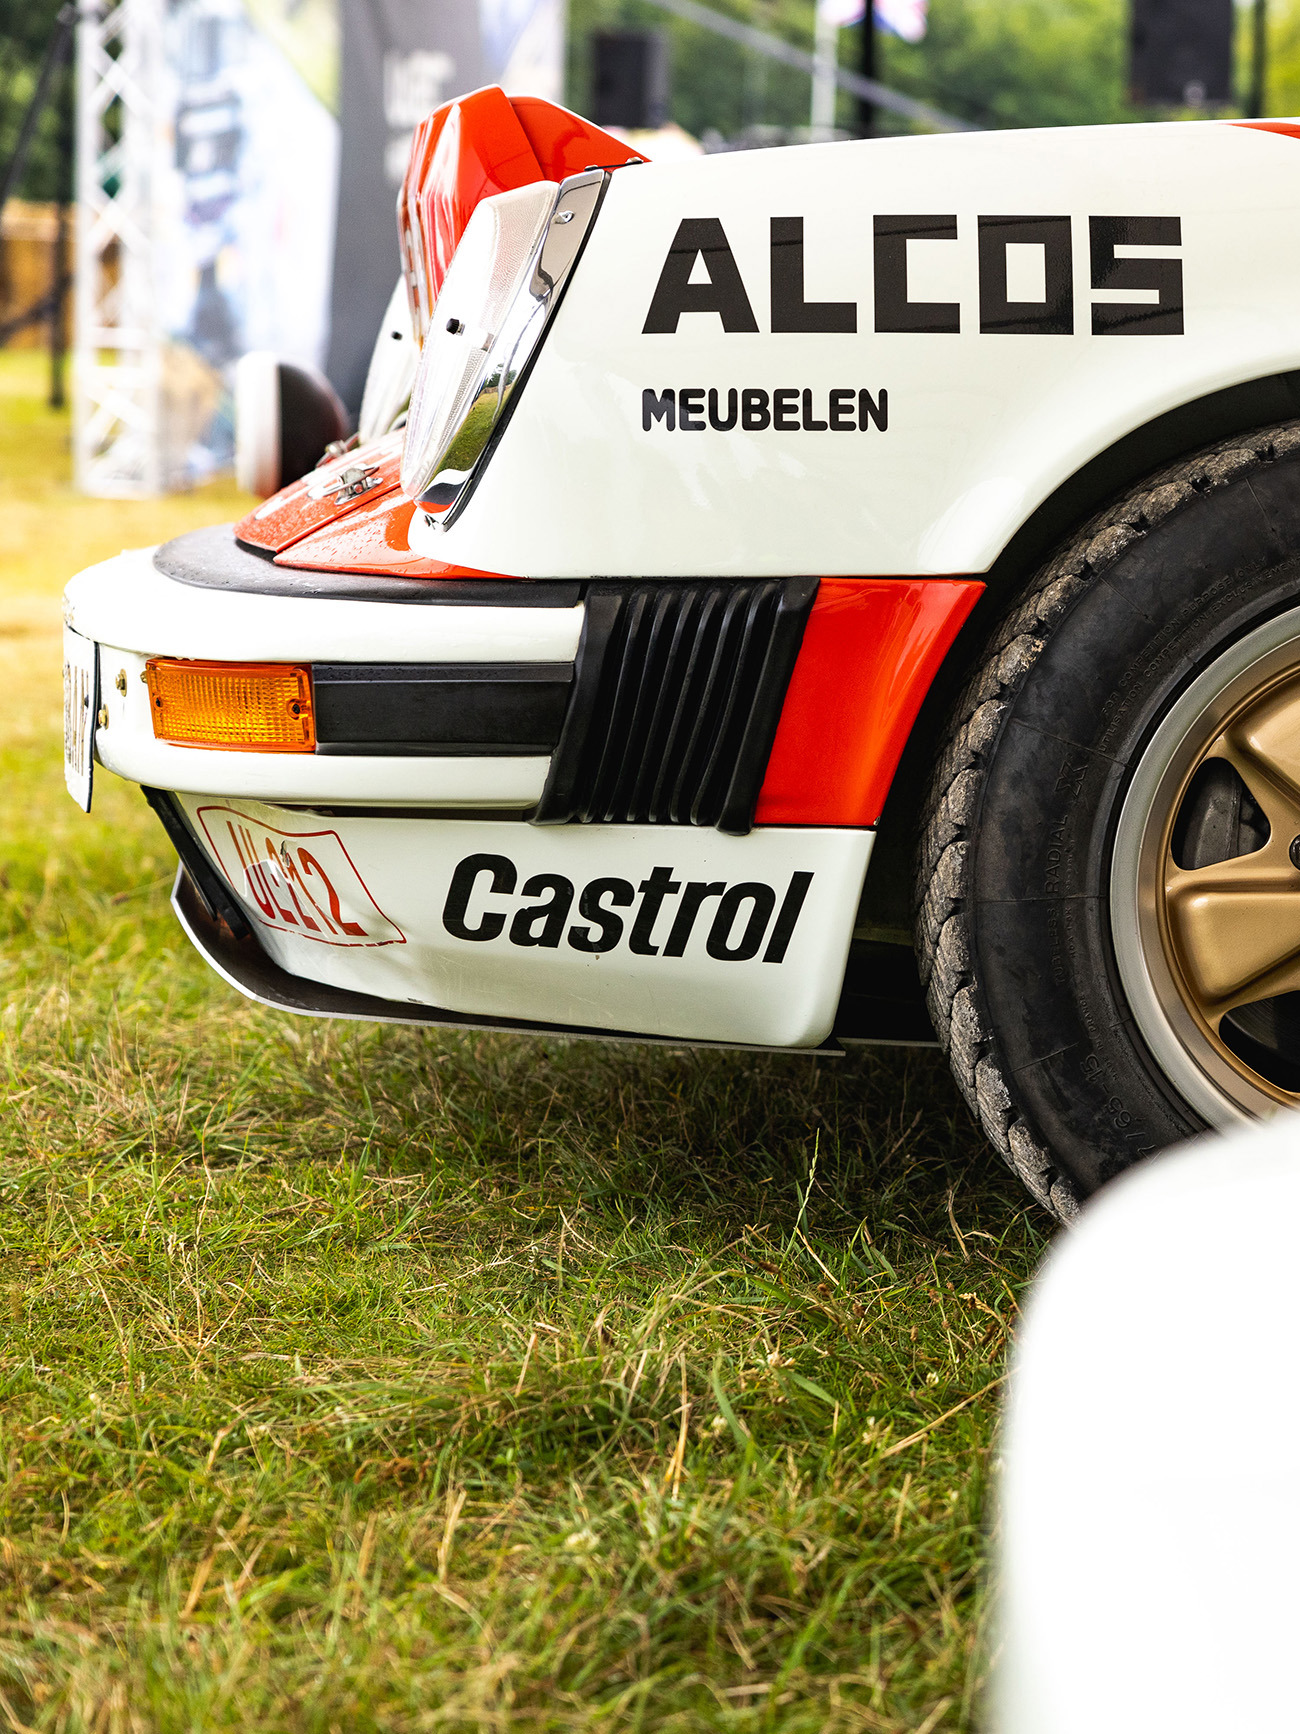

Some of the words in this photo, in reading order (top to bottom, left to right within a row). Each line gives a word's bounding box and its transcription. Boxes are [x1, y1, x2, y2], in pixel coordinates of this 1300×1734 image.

[641, 214, 1184, 336] ALCOS
[641, 387, 889, 432] MEUBELEN
[1045, 813, 1070, 894] RADIAL
[442, 852, 814, 964] Castrol
